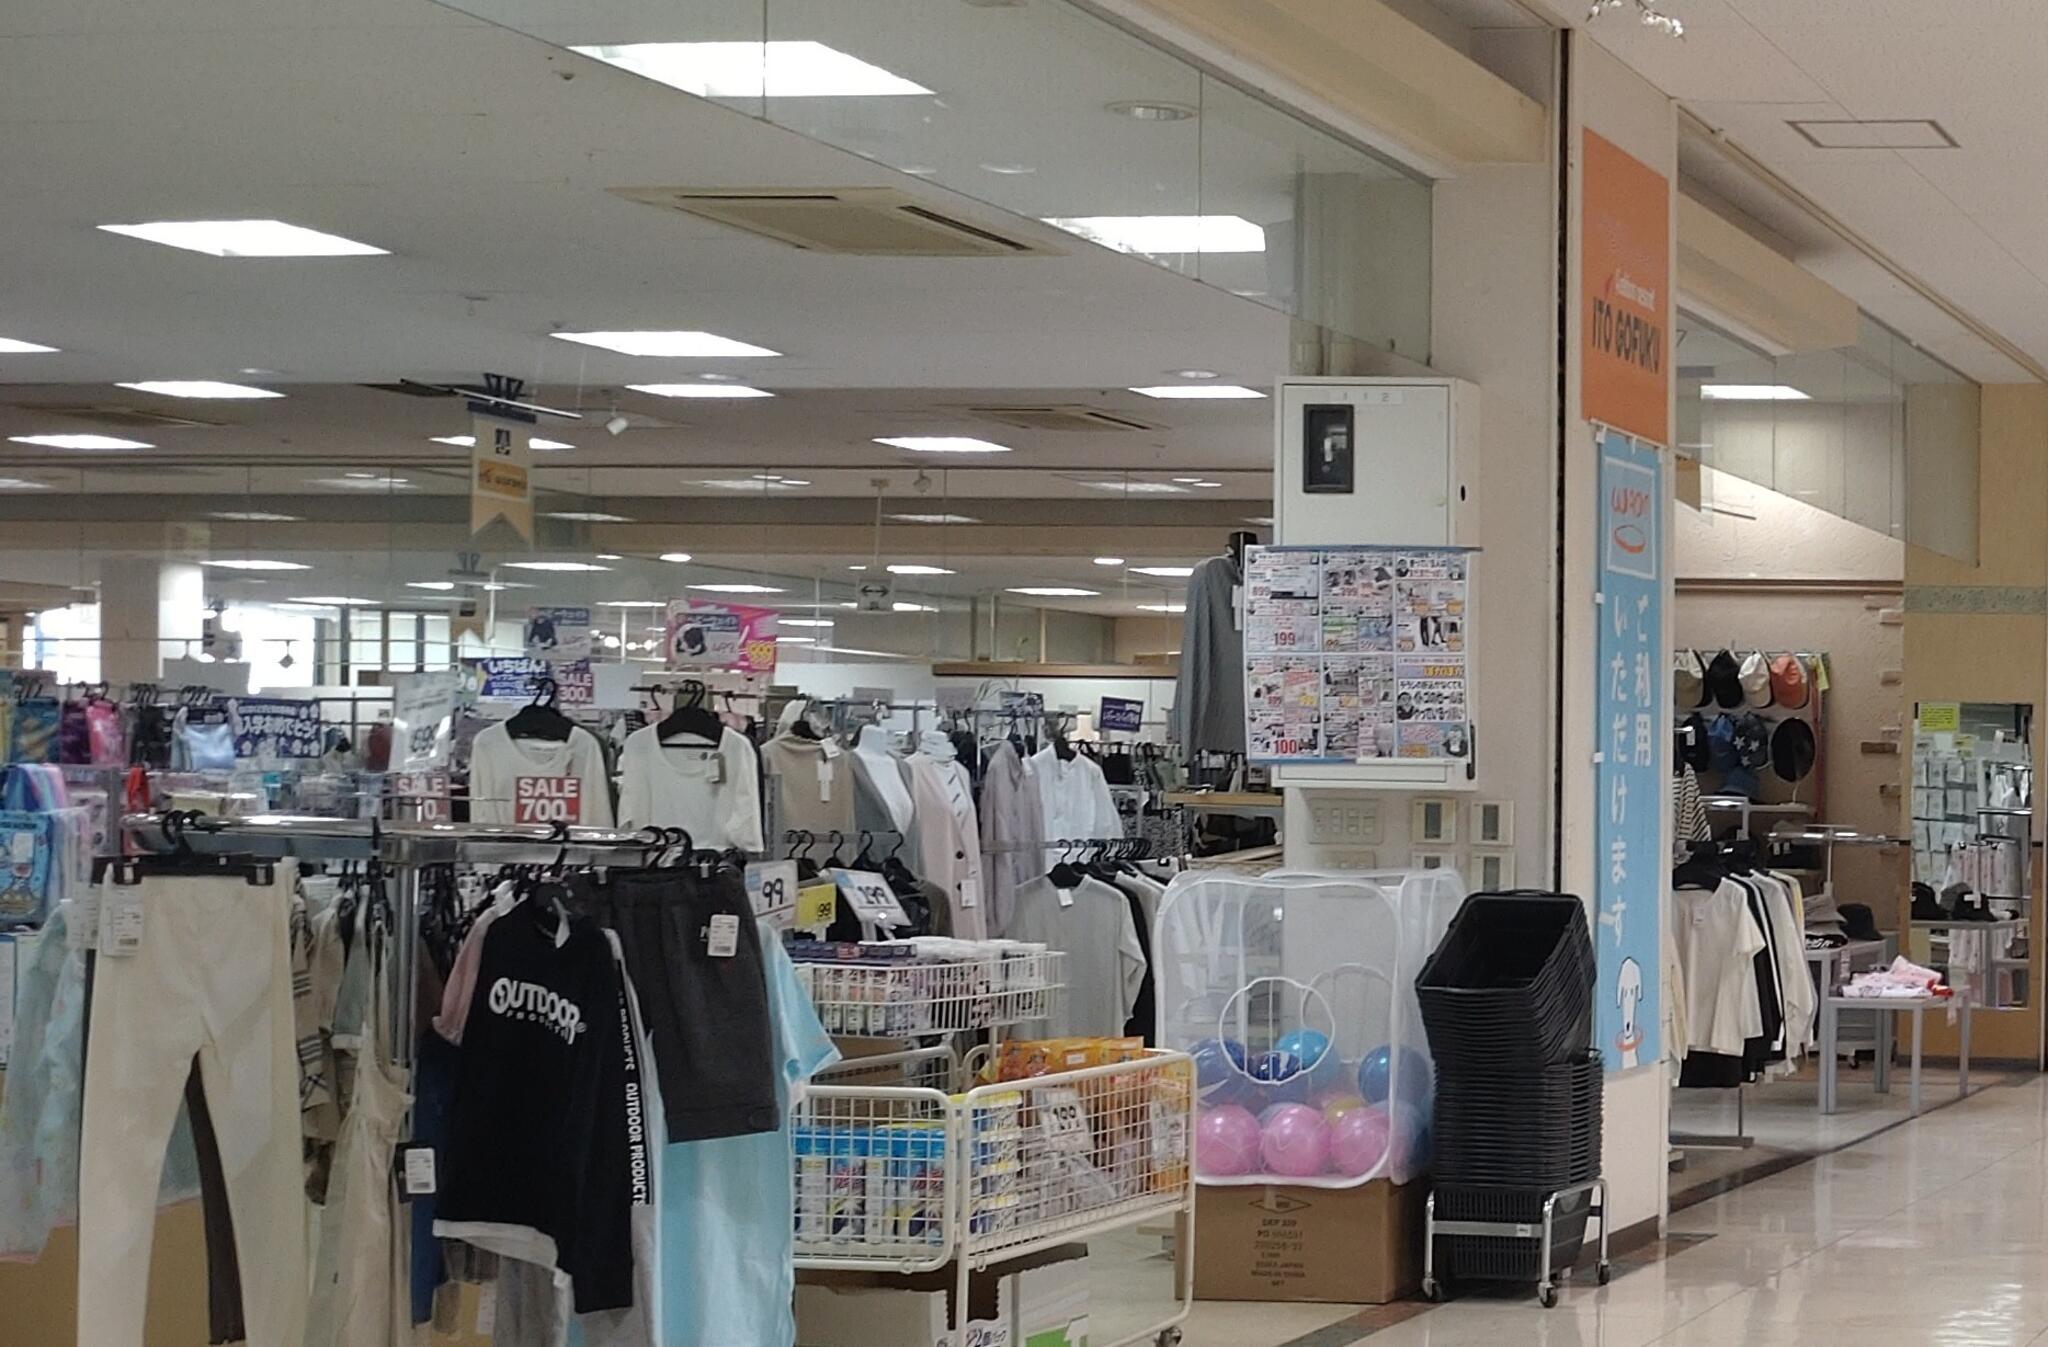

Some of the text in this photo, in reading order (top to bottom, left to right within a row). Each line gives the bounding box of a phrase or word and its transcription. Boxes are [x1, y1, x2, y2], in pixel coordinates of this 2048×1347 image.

[1592, 297, 1661, 374] ITO GOFUKU
[1274, 632, 1296, 646] 199
[559, 673, 593, 686] SALE
[559, 687, 586, 701] 300
[1273, 739, 1298, 754] 100
[1610, 594, 1628, 948] いただけます
[518, 777, 578, 798] SALE
[520, 799, 566, 821] 700
[762, 877, 784, 908] 99
[488, 977, 581, 1045] OUTDOOR
[624, 1082, 643, 1144] OUTDOOR
[629, 1144, 650, 1207] PRODUCTS
